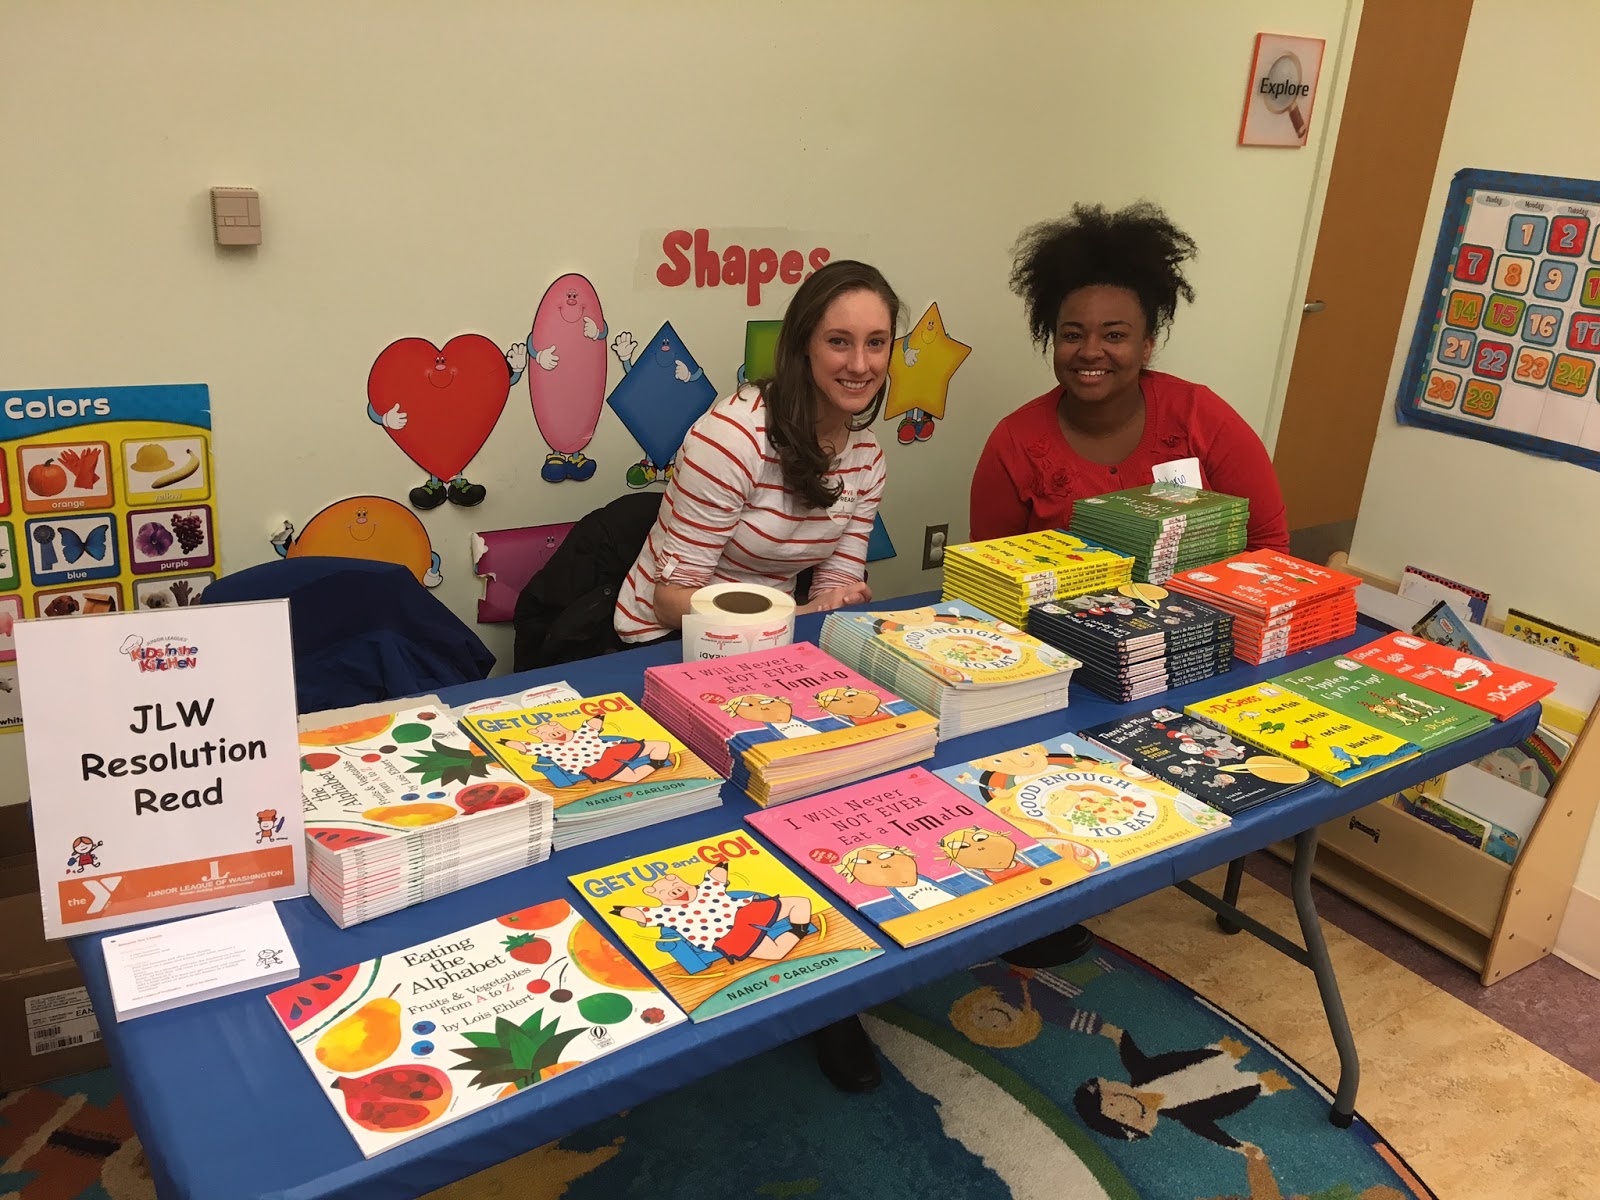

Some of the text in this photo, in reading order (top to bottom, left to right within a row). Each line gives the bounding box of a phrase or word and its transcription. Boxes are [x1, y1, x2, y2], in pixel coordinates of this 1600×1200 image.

[1260, 78, 1309, 98] Explore
[1524, 200, 1545, 211] Monday
[1567, 206, 1589, 217] Tuesday
[1521, 223, 1578, 248] 1 2
[656, 228, 831, 306] Shapes
[1467, 252, 1563, 292] 7 8 9
[1452, 298, 1600, 346] 14 15 16 17
[1443, 336, 1586, 388] 21 22 23 24
[1427, 377, 1496, 411] 28 29
[4, 395, 111, 420] Colors
[51, 491, 182, 510] orange yellow
[66, 559, 189, 581] blue purple
[177, 645, 199, 657] the
[905, 627, 1004, 650] GOOD ENOUGH
[963, 661, 987, 670] TO
[991, 655, 1018, 669] EAT
[1352, 647, 1383, 661] Green
[1377, 652, 1405, 664] Eggs
[681, 656, 790, 681] I Will Never
[722, 663, 810, 685] NOT EVER
[1285, 675, 1315, 685] Ten
[1395, 663, 1415, 674] and
[1411, 669, 1436, 681] Ham
[727, 684, 757, 694] Eat
[1305, 675, 1350, 692] Apples
[1320, 673, 1385, 701] Up On Top!
[1498, 680, 1533, 694] Seuss
[129, 698, 215, 735] JLW
[477, 696, 635, 734] GET UP and GO!
[1215, 700, 1235, 714] Dr.
[1226, 694, 1262, 708] Seuss
[1265, 700, 1301, 714] One fish
[1098, 716, 1151, 740] There's No Place
[1295, 710, 1330, 725] two fish
[1111, 726, 1147, 744] Like Space!
[1320, 723, 1352, 738] red fish
[1346, 734, 1384, 749] blue fish
[81, 737, 267, 781] Resolution
[134, 777, 224, 816] Read
[311, 786, 332, 802] the
[315, 770, 362, 807] Alphabet
[585, 781, 686, 807] NANCY CARLSON
[1020, 772, 1133, 818] GOOD ENOUGH
[784, 788, 904, 831] I Will Never
[830, 796, 928, 833] NOT EVER
[838, 831, 872, 846] Eat
[878, 826, 889, 835] a
[1089, 810, 1155, 838] TO EAT
[1115, 829, 1193, 860] LIZZY ROCKWELL
[583, 835, 761, 899] GET UP and GO!
[67, 875, 123, 915] the Y
[146, 887, 178, 898] JUNIOR
[179, 880, 213, 892] LEAGUE
[228, 869, 283, 884] WASHINGTON
[907, 886, 939, 901] Charlie
[914, 884, 1033, 932] lauren child
[401, 937, 475, 967] Eating
[430, 956, 466, 973] the
[412, 954, 506, 995] Alphabet
[726, 956, 839, 1001] NANCY CARLSON
[407, 967, 532, 1016] Fruits & Vegetables
[440, 982, 515, 1015] from A to Z
[441, 994, 535, 1033] by Lois Ehlert
